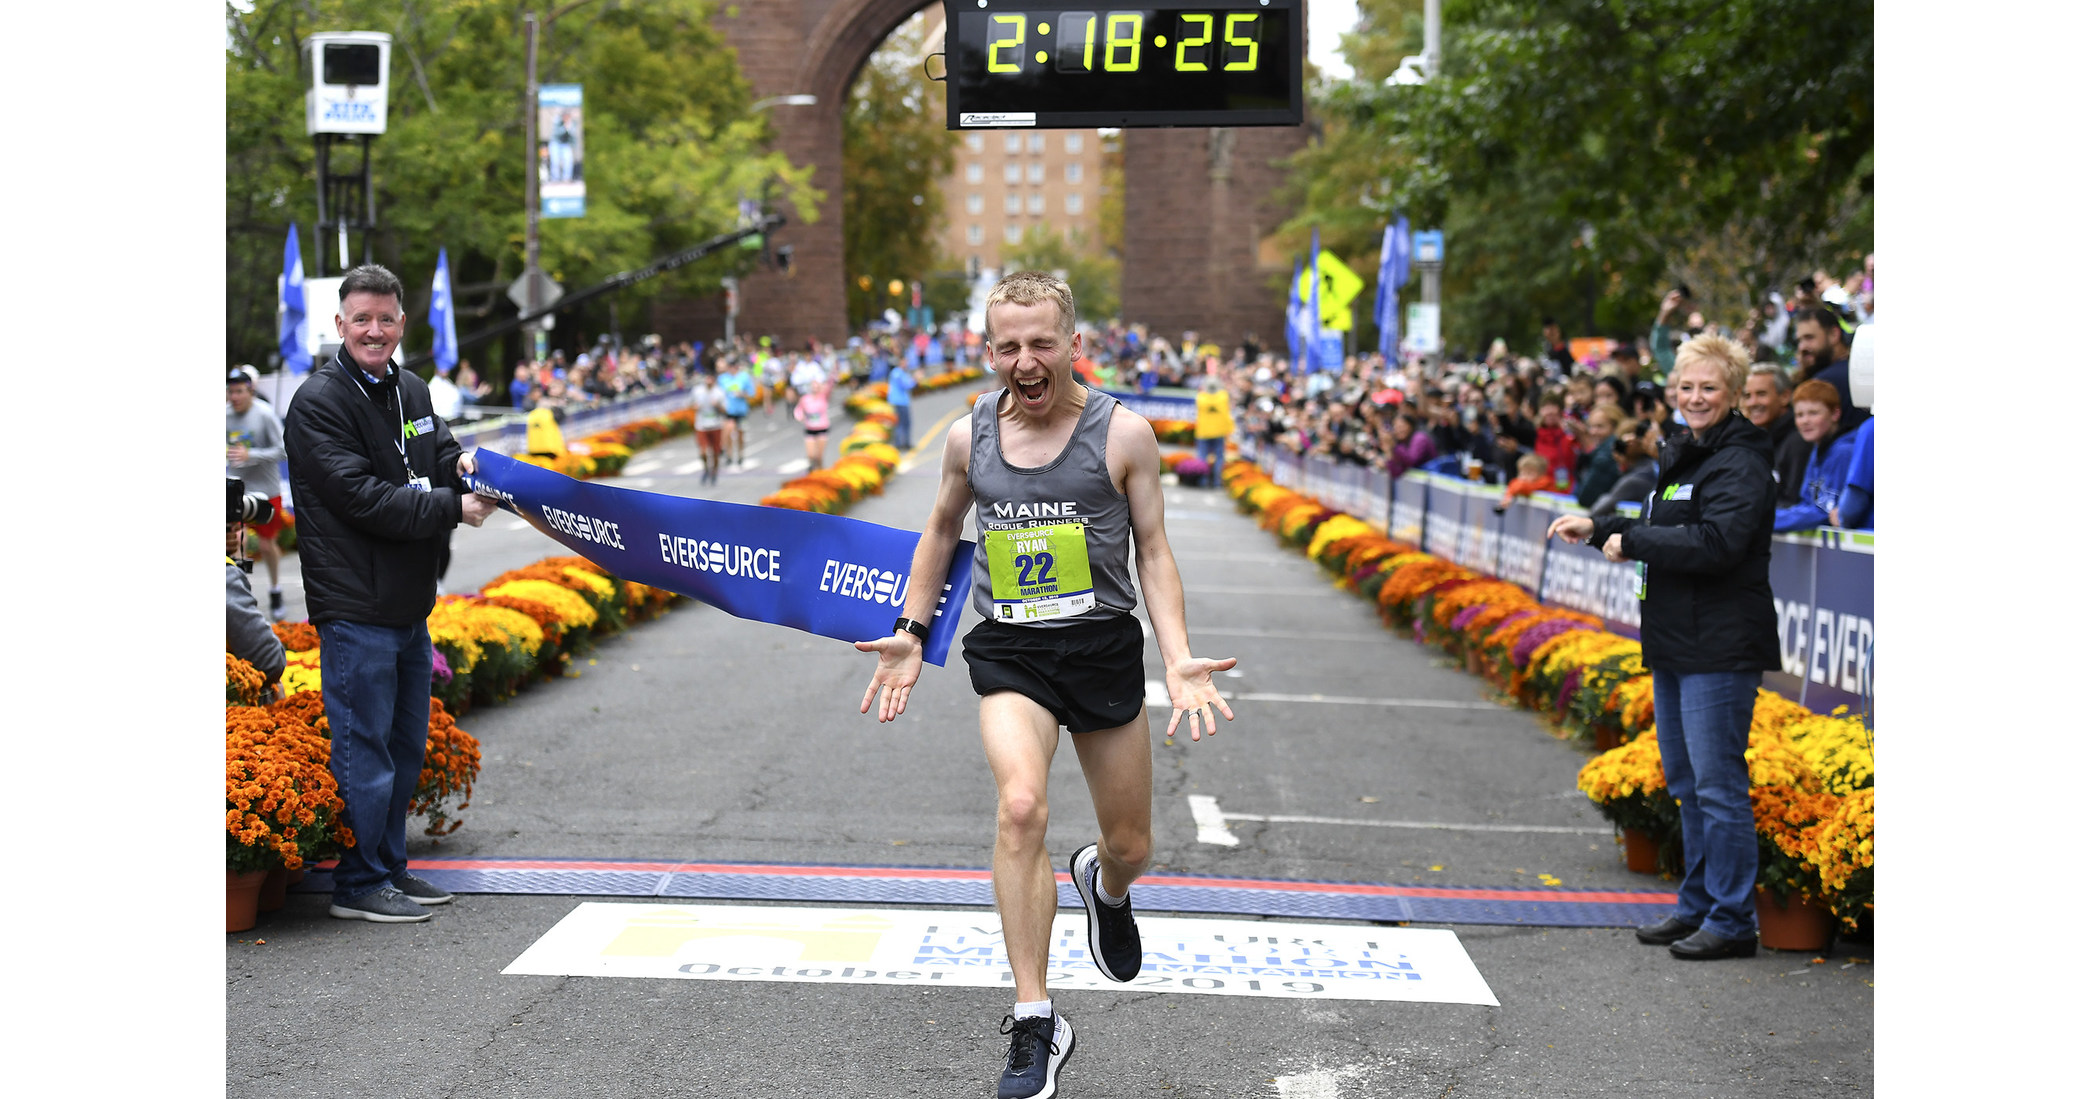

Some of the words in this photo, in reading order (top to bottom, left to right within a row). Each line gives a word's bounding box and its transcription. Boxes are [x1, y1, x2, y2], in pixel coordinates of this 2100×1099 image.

[993, 502, 1077, 518] MAINE
[541, 504, 626, 551] EVERSOURCE
[988, 522, 1024, 531] ROGUE
[1028, 517, 1089, 529] RUNNERS
[1007, 528, 1054, 541] EVERSOURCE
[1016, 538, 1048, 554] RYAN
[658, 532, 781, 582] EVERSOURCE
[1015, 552, 1057, 587] 22
[1020, 584, 1058, 596] MARATHON
[678, 962, 957, 980] October
[1132, 975, 1325, 993] 2019
